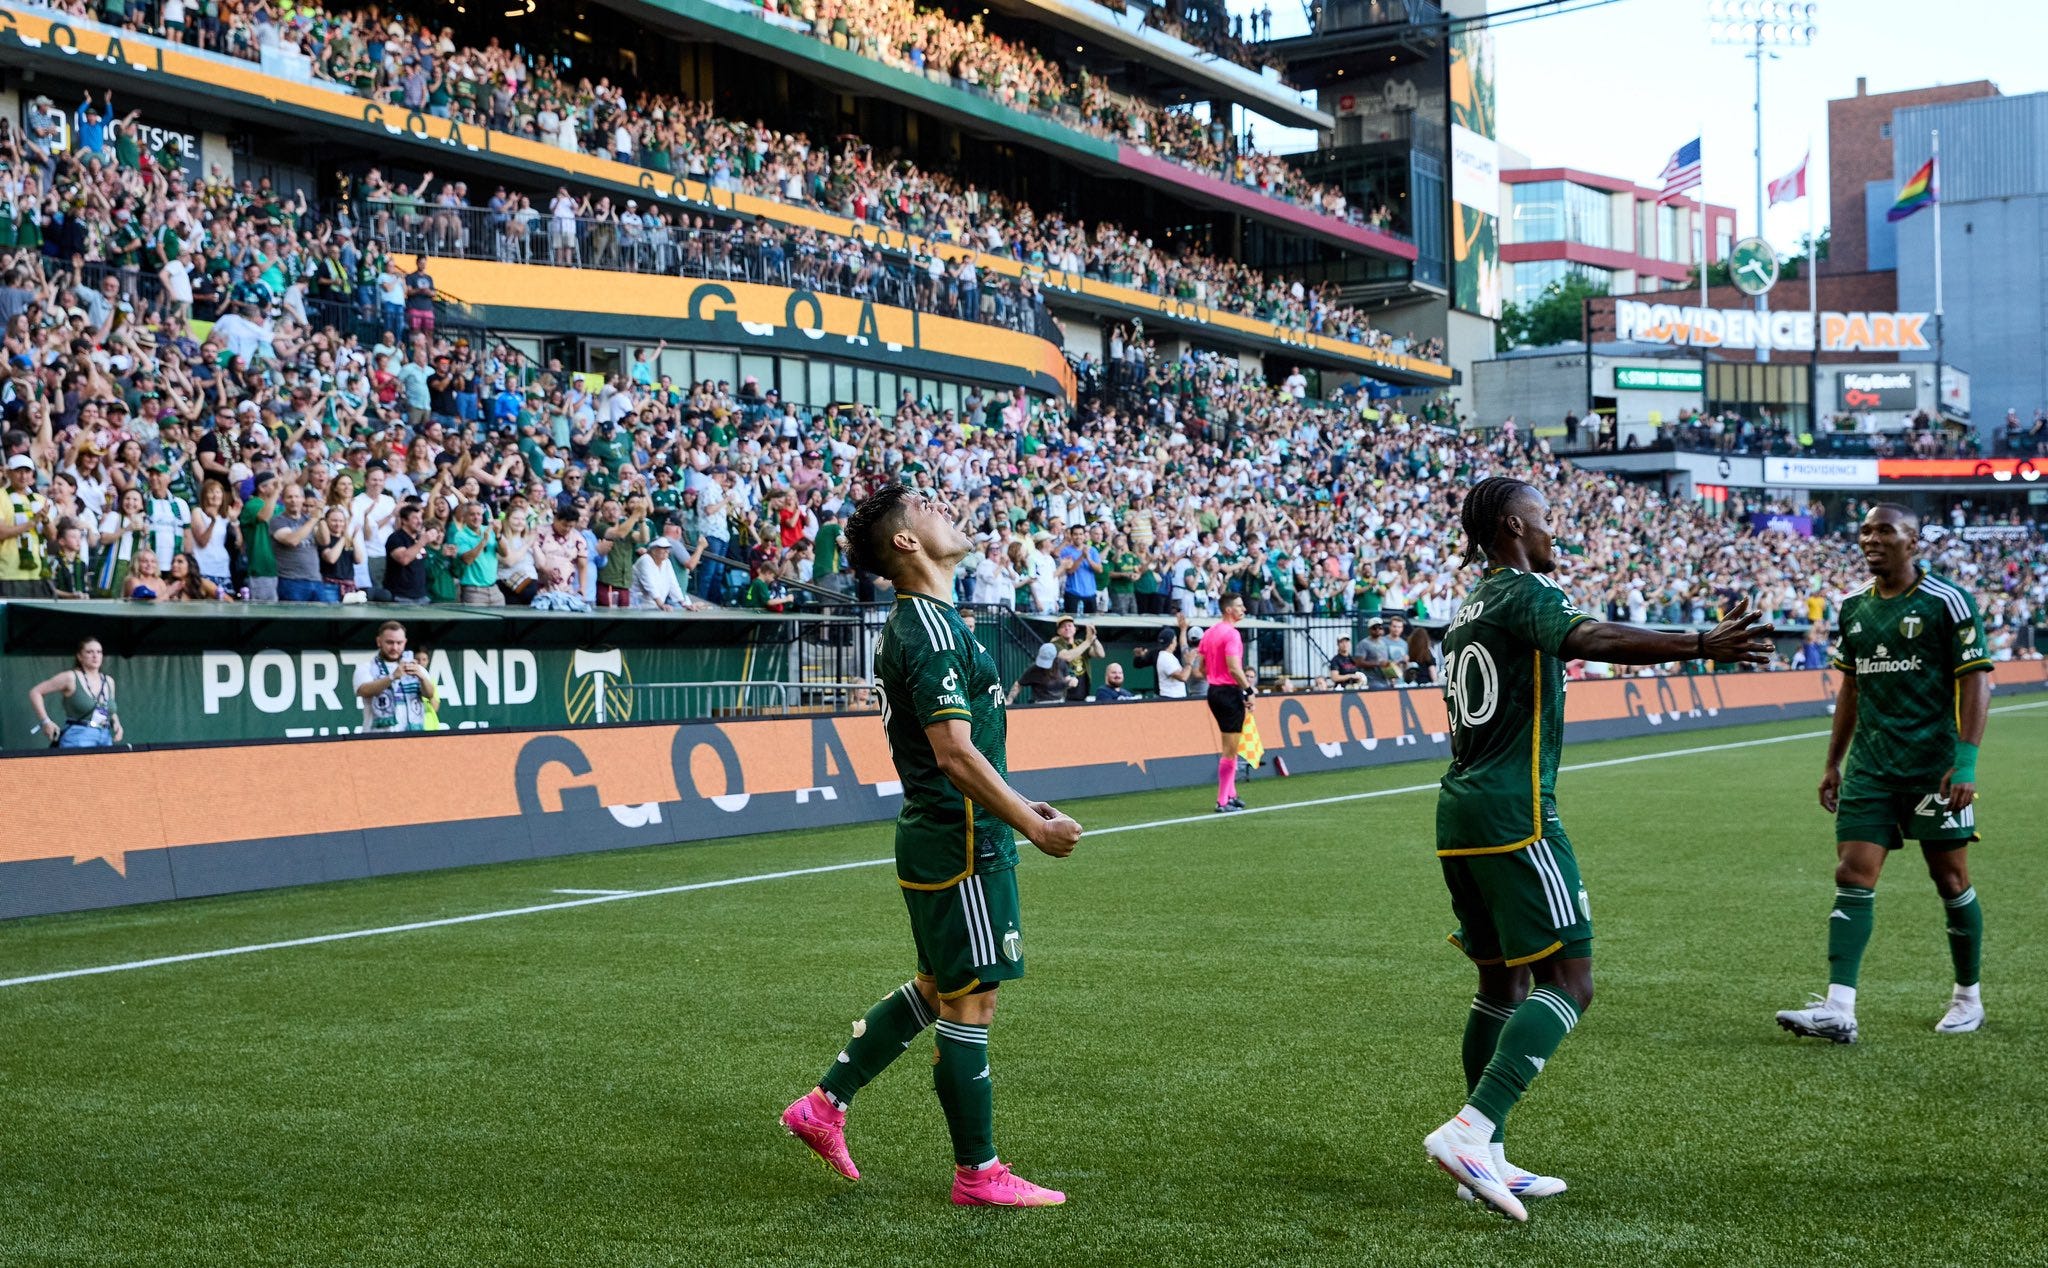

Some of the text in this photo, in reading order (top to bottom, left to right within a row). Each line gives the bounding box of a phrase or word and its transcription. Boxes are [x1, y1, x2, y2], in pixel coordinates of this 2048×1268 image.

[852, 224, 910, 254] GOA
[1616, 299, 1931, 350] PROVIDENCE PARK
[1844, 373, 1912, 392] KeyBank
[203, 649, 538, 714] PORTAND
[937, 694, 967, 707] TikTok
[1279, 692, 1447, 759] GOA
[514, 718, 903, 828] GOA
